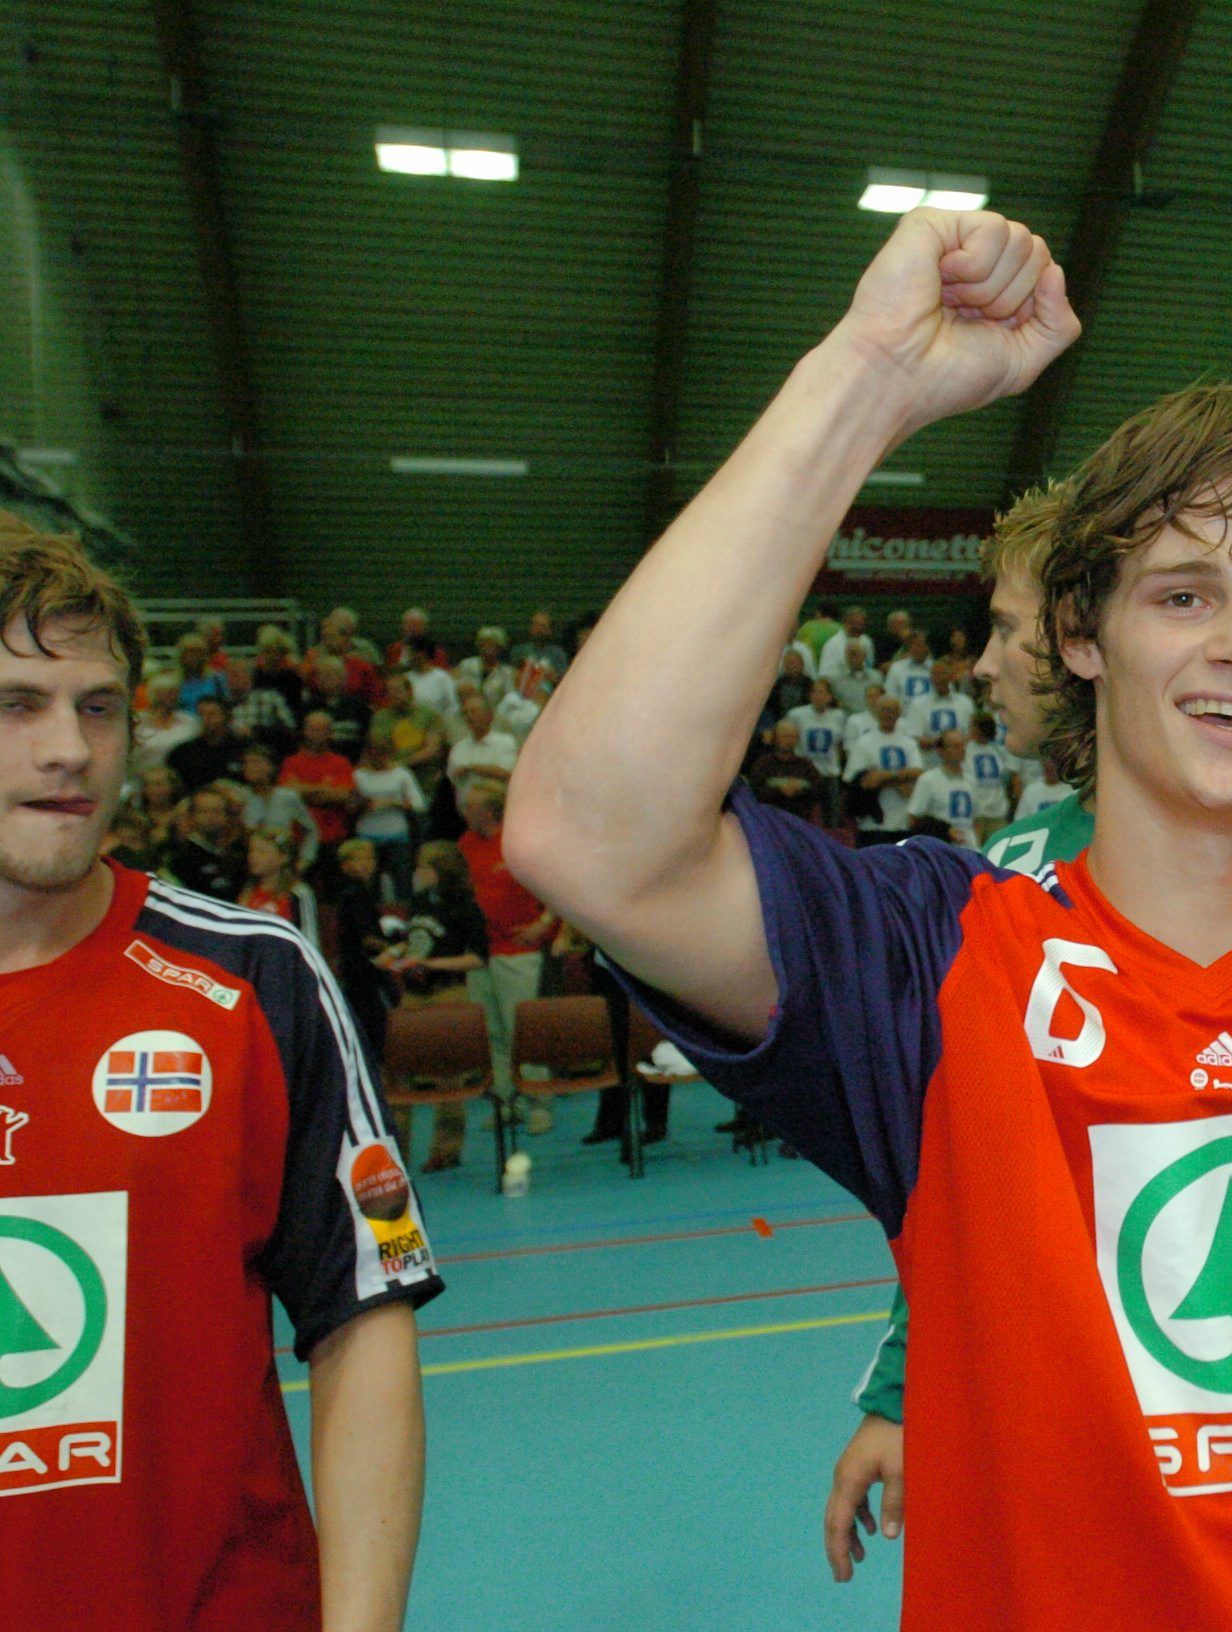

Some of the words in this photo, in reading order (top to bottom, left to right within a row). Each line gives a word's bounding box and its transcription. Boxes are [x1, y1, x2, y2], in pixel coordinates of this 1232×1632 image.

[146, 958, 214, 994] SPAR
[1023, 937, 1119, 1069] 6
[378, 1230, 426, 1261] RIGHT
